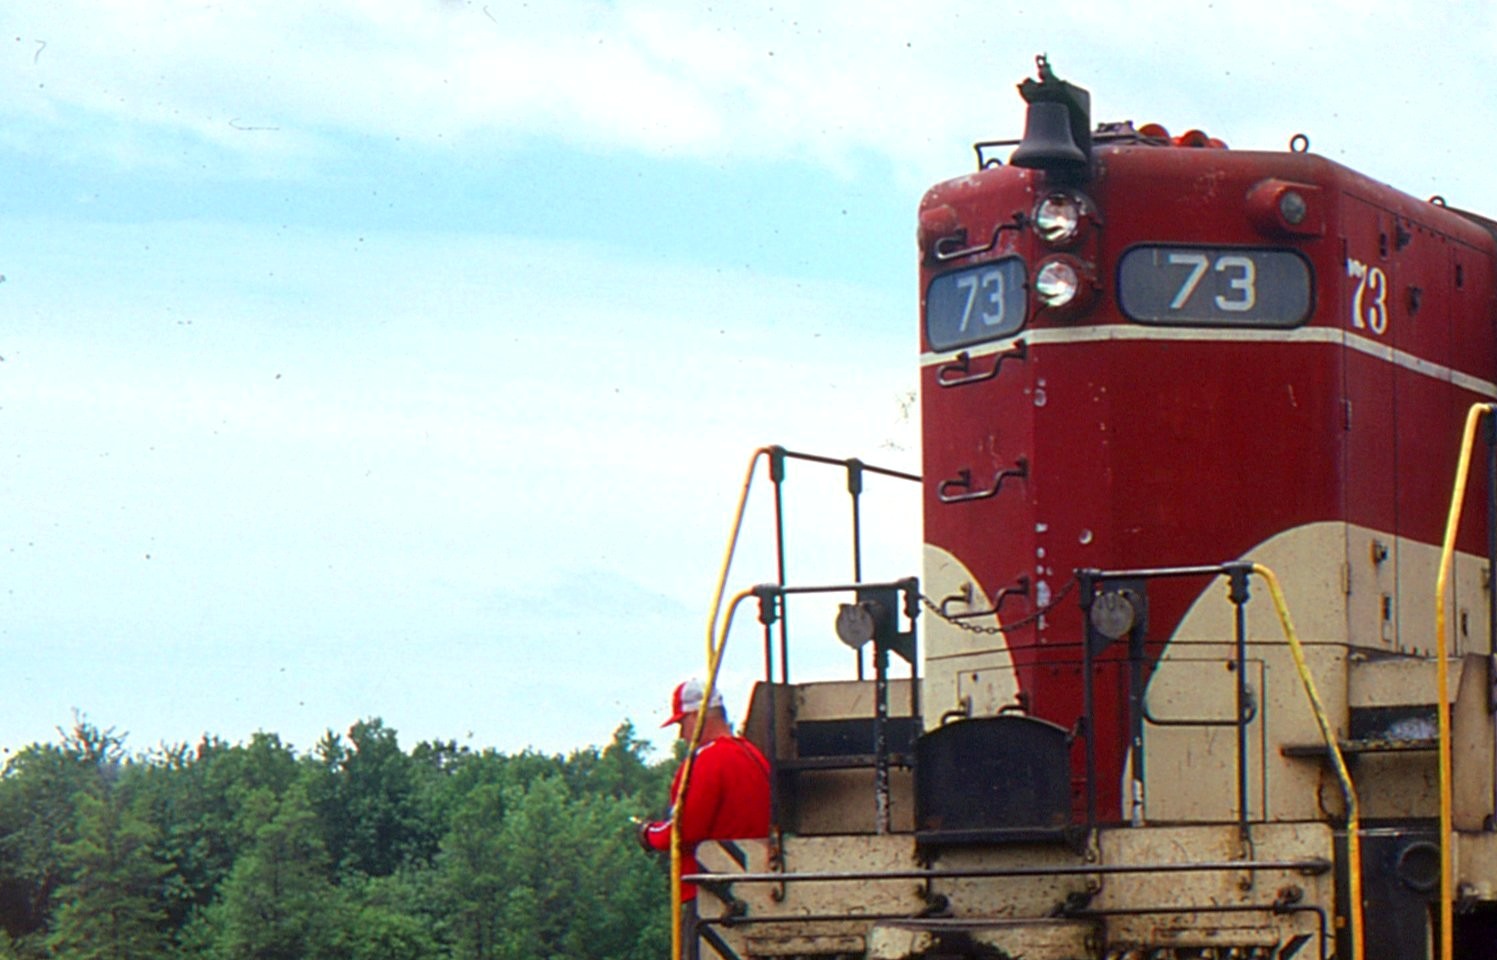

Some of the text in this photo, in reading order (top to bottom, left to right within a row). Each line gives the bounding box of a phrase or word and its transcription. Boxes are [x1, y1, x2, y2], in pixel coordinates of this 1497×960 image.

[957, 270, 1004, 332] 73
[1168, 253, 1256, 311] 73
[1346, 257, 1388, 335] 73
